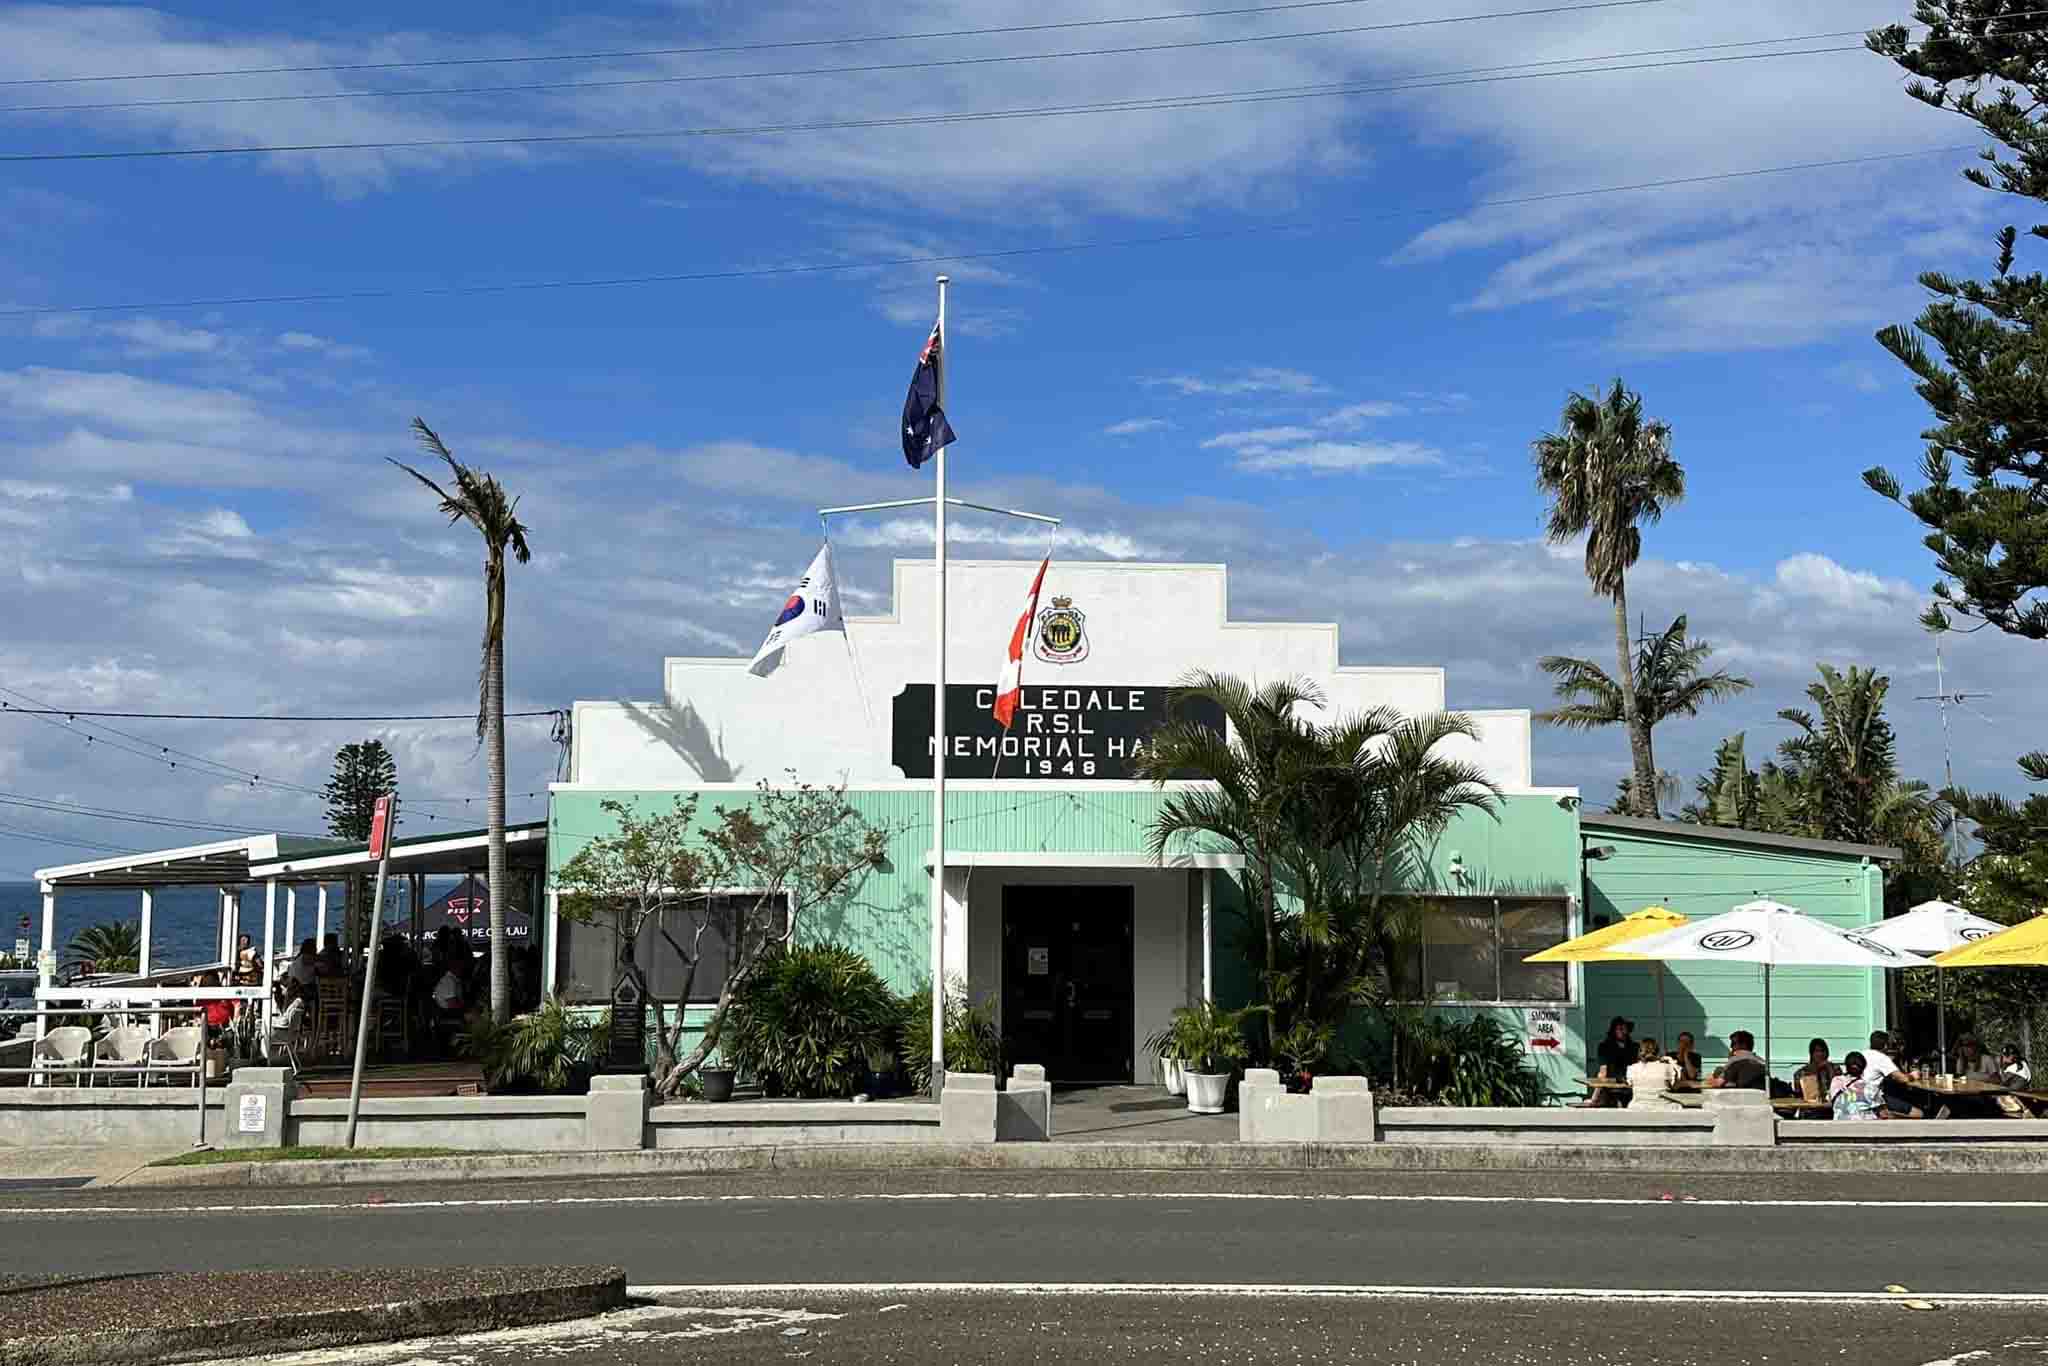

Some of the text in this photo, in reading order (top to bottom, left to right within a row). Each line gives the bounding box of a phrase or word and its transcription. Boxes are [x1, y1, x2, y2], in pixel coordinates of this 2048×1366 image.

[976, 689, 1145, 711] CLEDALE
[1107, 736, 1168, 758] HA
[1025, 759, 1096, 776] 1948
[1531, 1010, 1561, 1022] SMOKING
[1537, 1023, 1554, 1034] AREA
